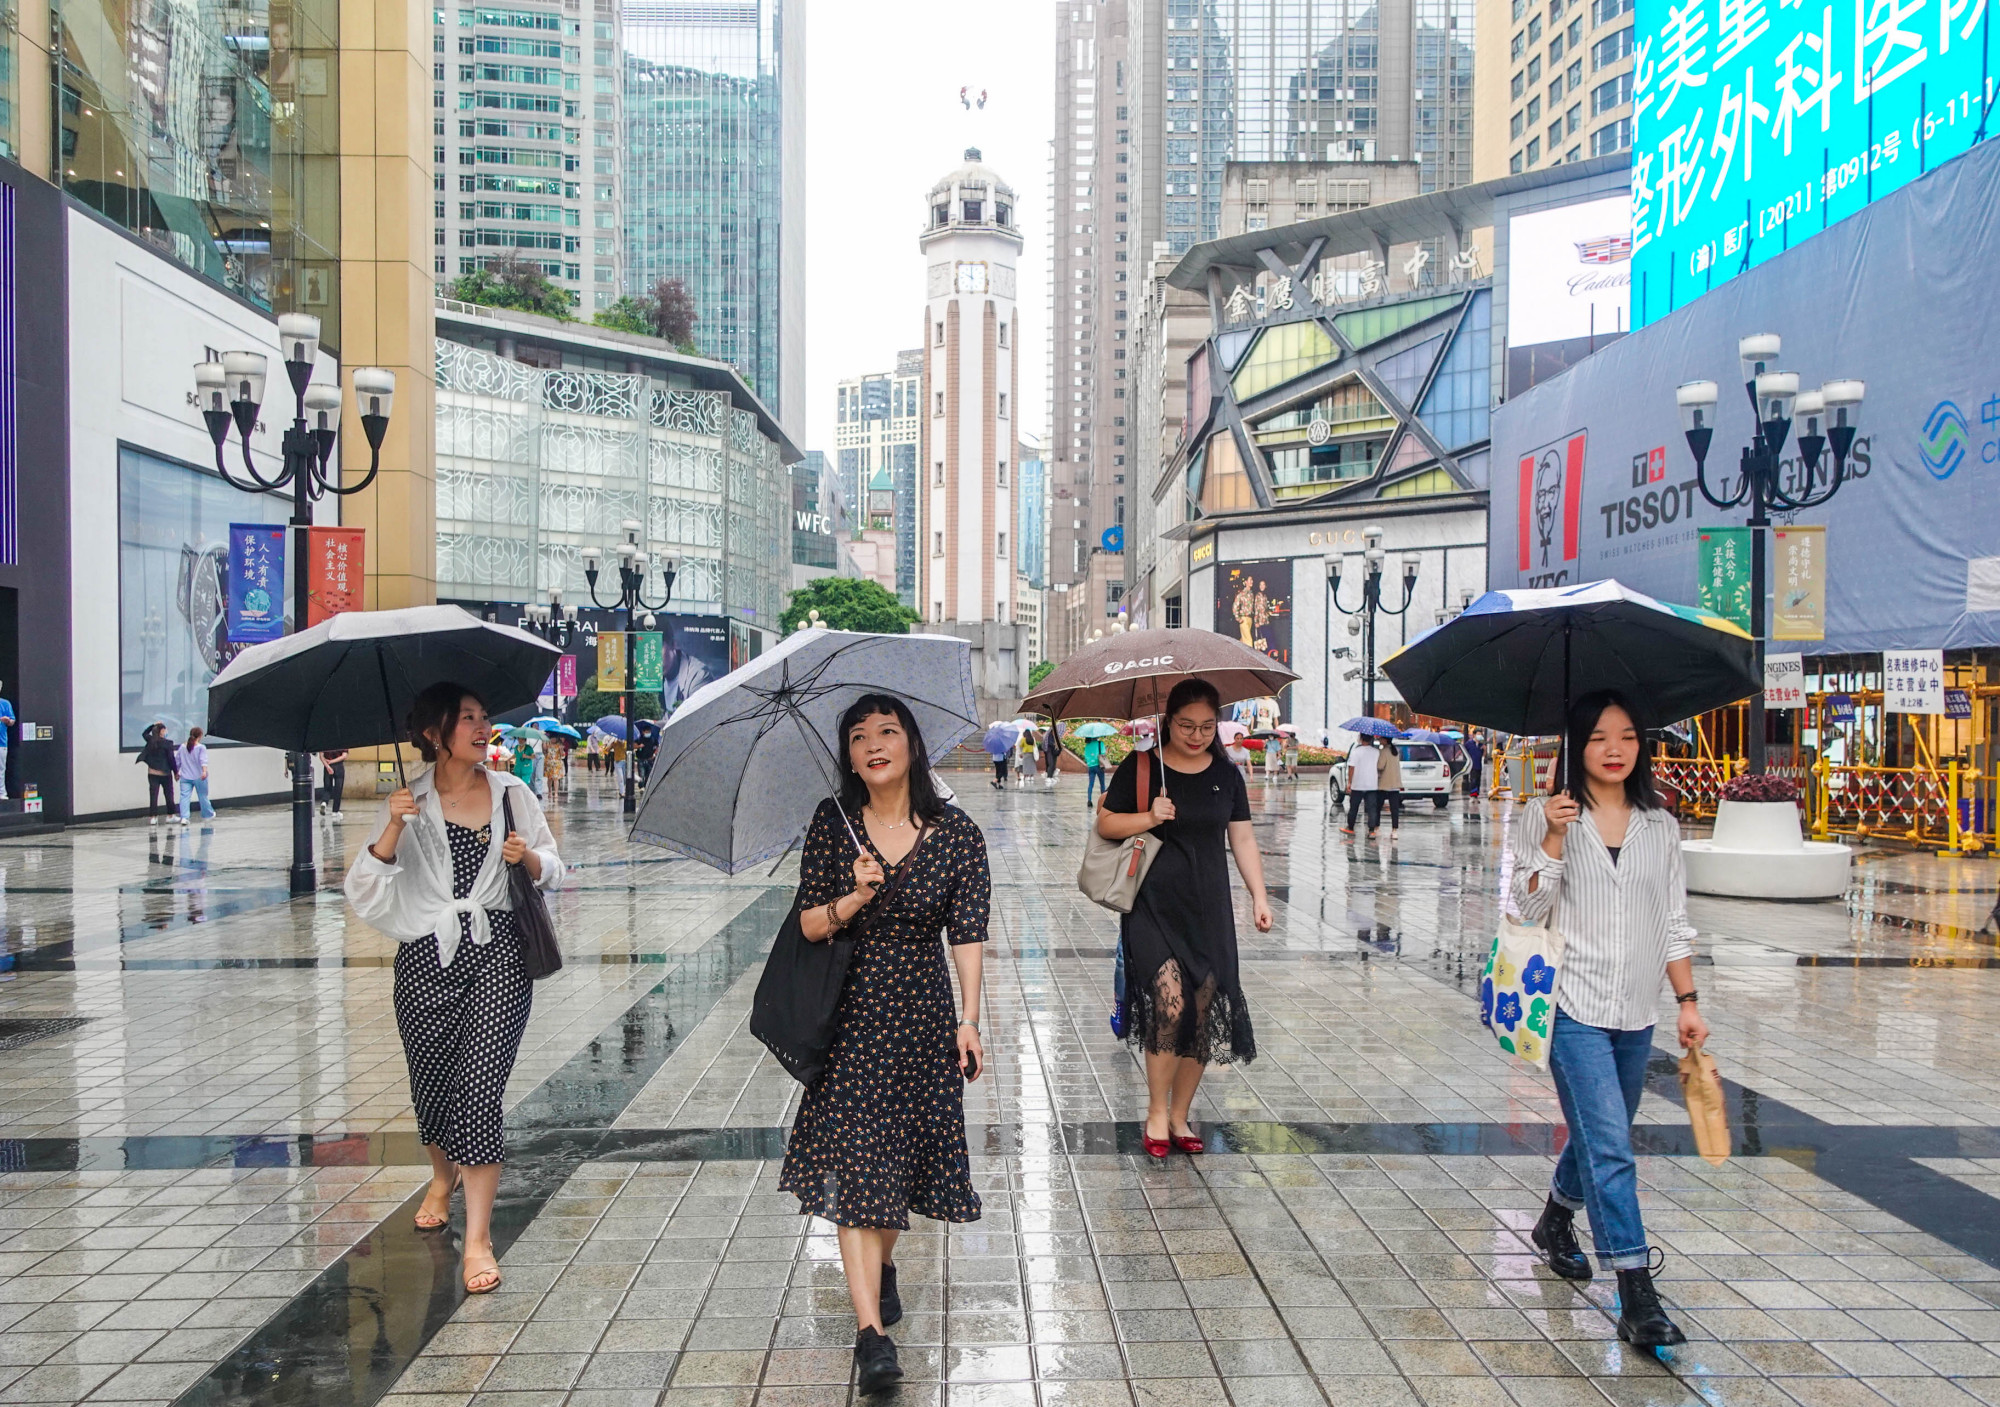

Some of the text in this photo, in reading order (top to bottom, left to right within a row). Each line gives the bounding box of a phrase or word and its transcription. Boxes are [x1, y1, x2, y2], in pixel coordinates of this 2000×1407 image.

[1223, 244, 1480, 317] 金鹰财富中心
[796, 510, 831, 535] WFC
[1600, 479, 1699, 538] TISSOT
[244, 534, 256, 581] 保护环境
[325, 537, 336, 581] 社会主义
[336, 543, 348, 593] 核心价值观
[1193, 542, 1213, 562] GUCCI
[1712, 547, 1724, 588] 卫生健康
[1724, 538, 1736, 580] 公筷公勺
[1788, 545, 1799, 587] 崇尚文明
[1124, 655, 1174, 670] ACIC
[1886, 657, 1939, 673] 名表维修中心
[1886, 677, 1939, 693] 正在营业中
